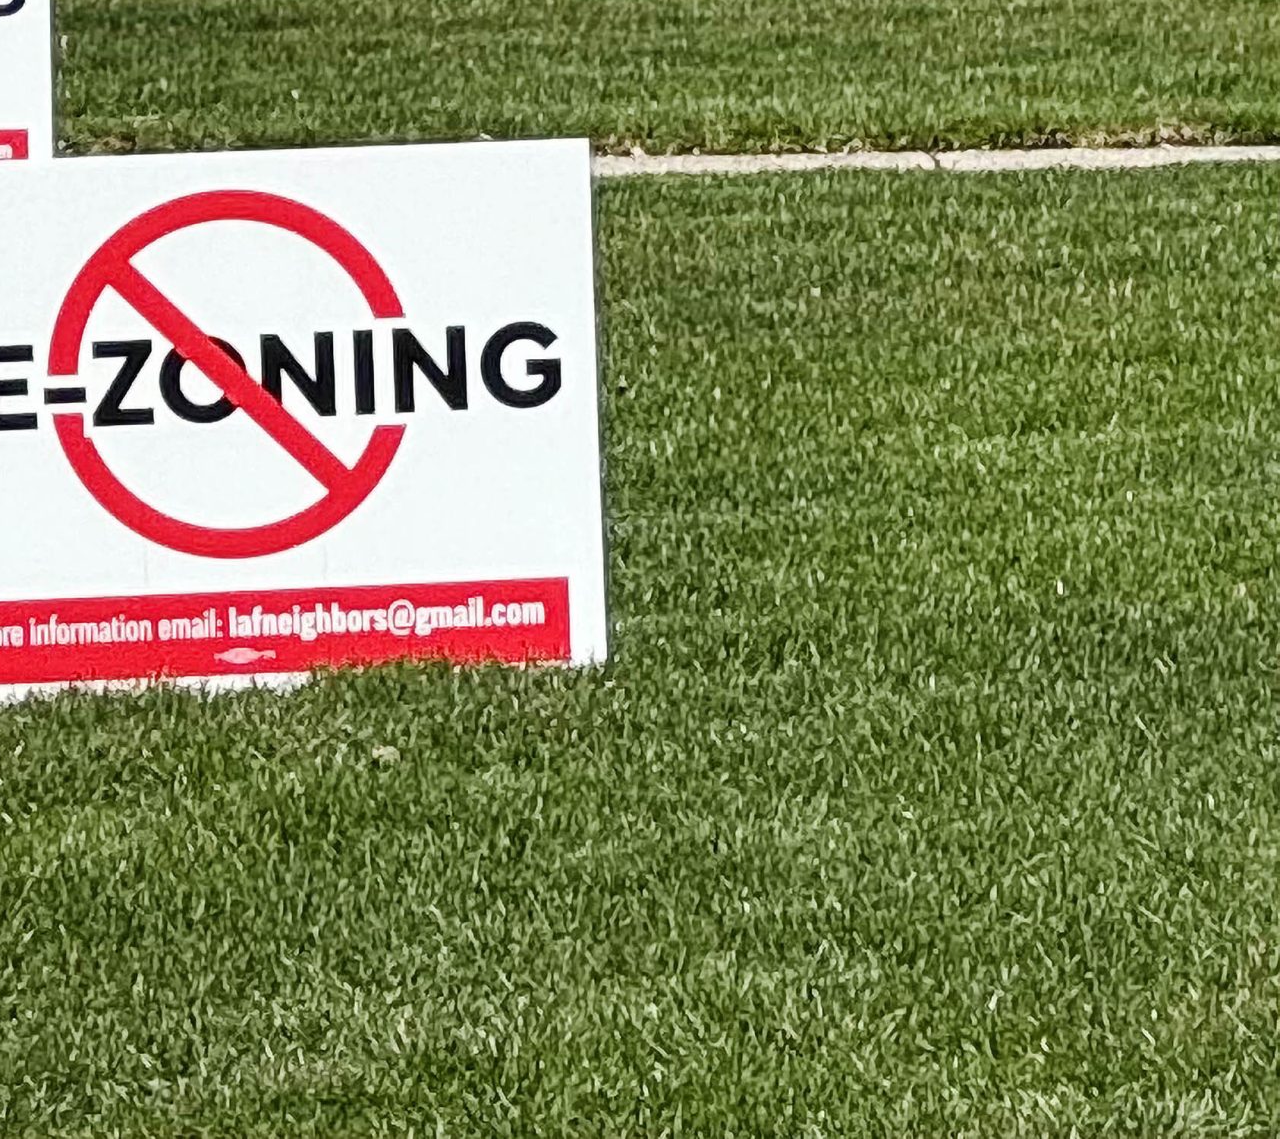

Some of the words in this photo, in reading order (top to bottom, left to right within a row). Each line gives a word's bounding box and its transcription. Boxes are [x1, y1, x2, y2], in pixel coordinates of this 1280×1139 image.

[29, 613, 153, 647] information
[158, 607, 224, 640] email:
[228, 595, 546, 642] lafneighbors@gmail.com
